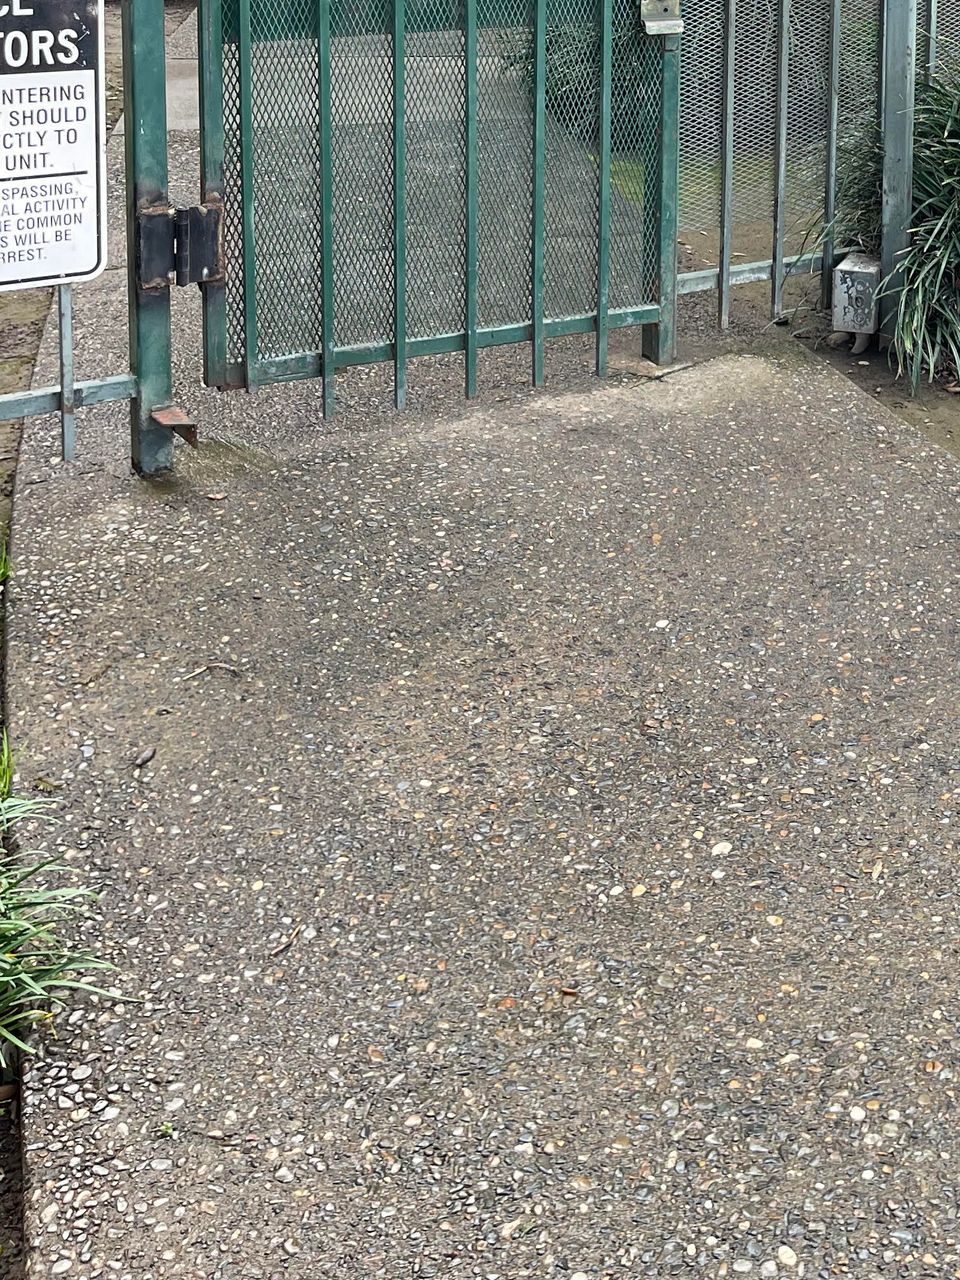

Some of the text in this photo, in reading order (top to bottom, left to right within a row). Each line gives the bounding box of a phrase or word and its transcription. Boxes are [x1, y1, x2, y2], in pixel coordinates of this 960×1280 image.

[0, 28, 80, 68] ORS
[2, 84, 85, 106] NTERING
[9, 106, 87, 127] SHOULD
[2, 128, 78, 150] CTLY TO
[5, 152, 54, 171] UNIT.
[1, 196, 88, 217] AL ACTIVITY
[0, 212, 82, 233] E COMMON
[14, 231, 50, 246] WILL
[55, 229, 72, 242] BE
